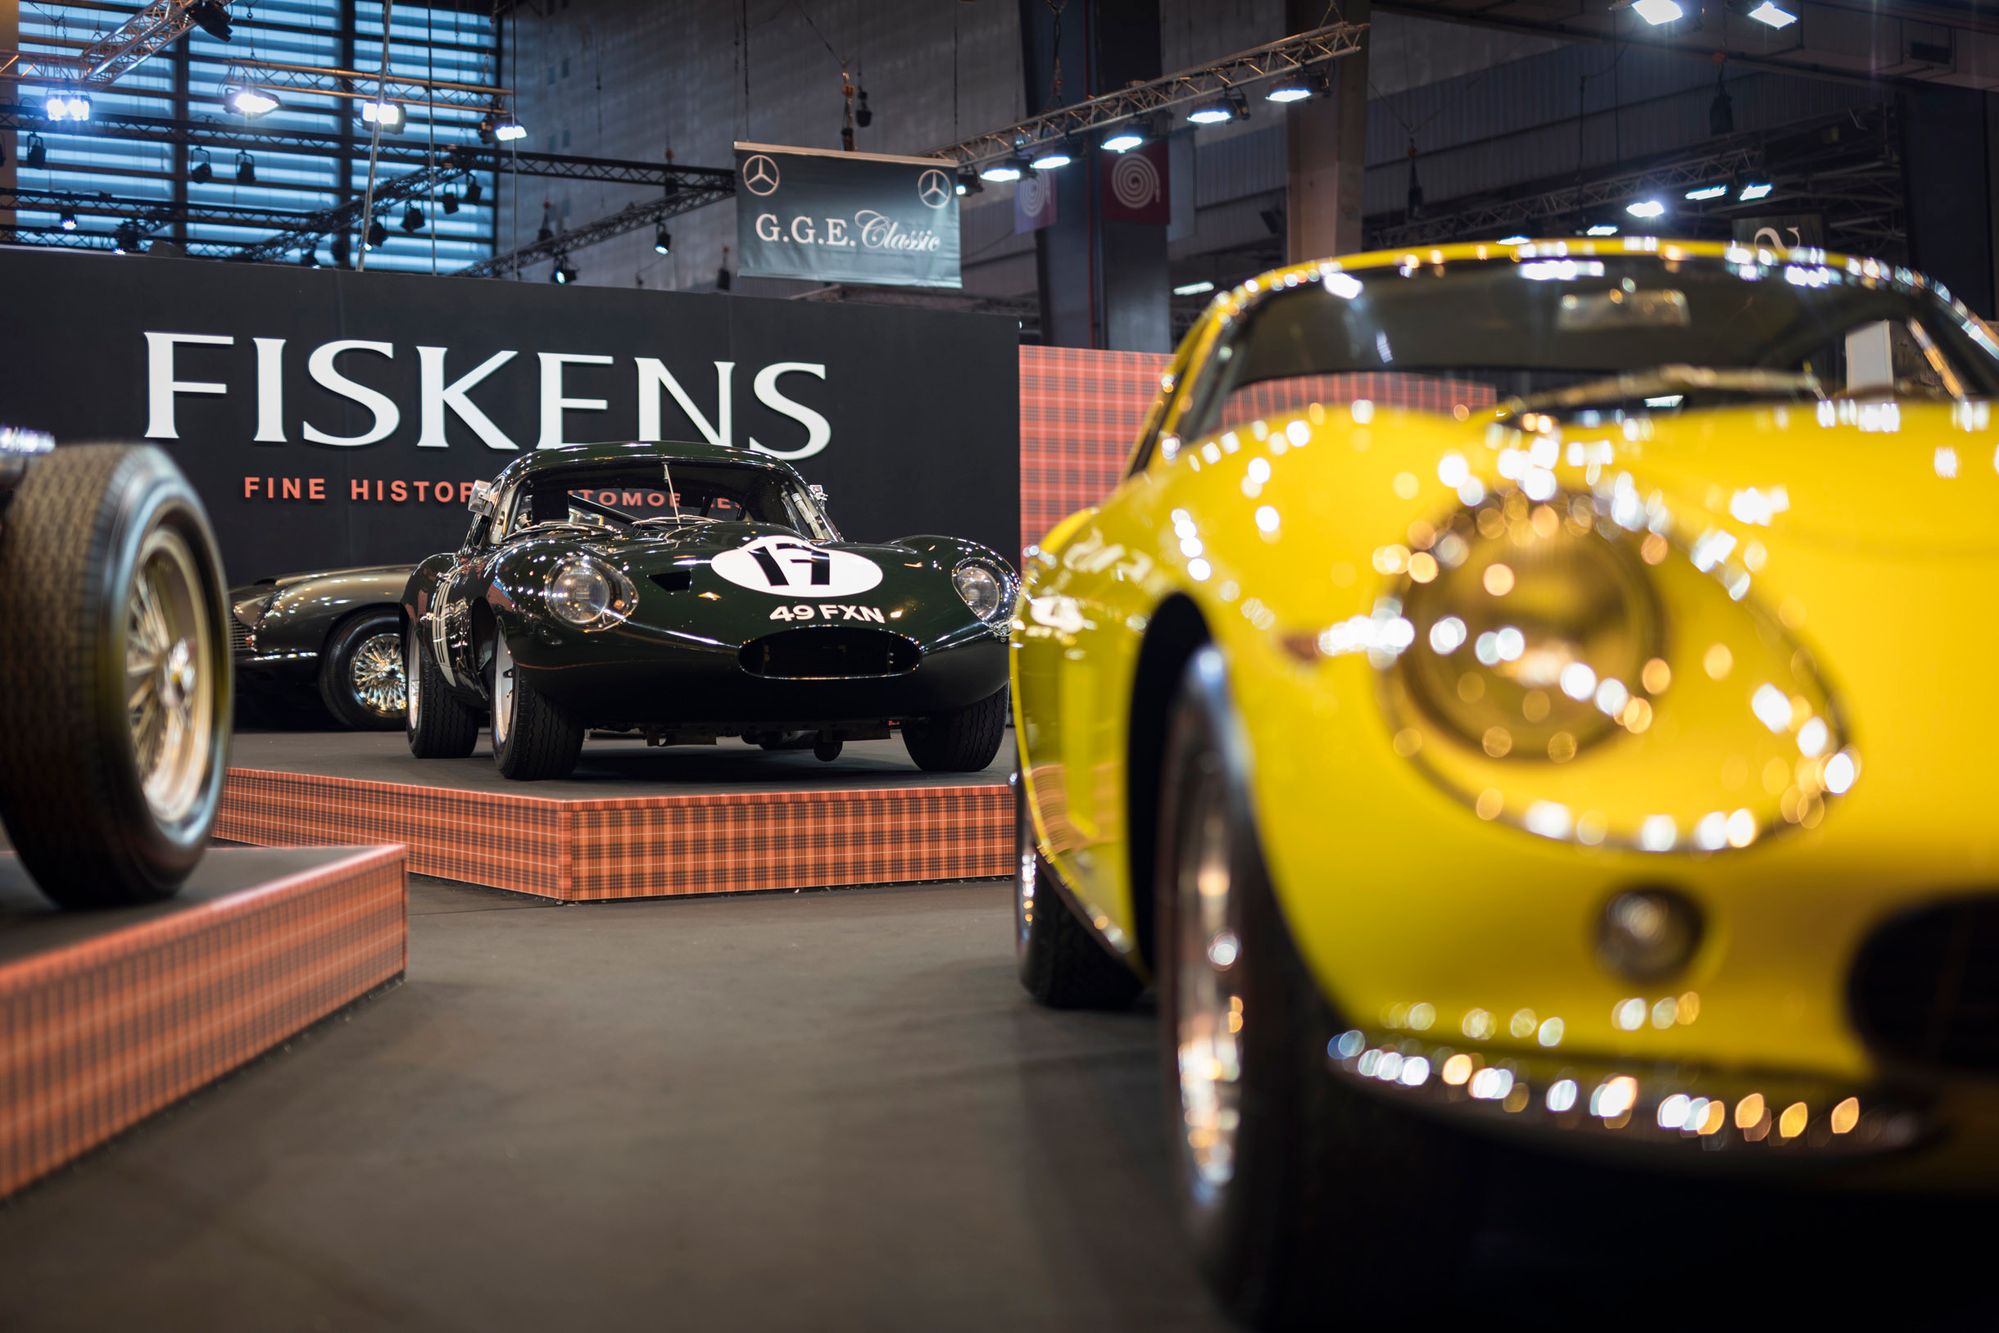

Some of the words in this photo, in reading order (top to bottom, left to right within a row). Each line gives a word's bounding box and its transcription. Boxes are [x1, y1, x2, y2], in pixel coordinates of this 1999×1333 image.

[755, 213, 856, 247] G.G.E.
[854, 209, 941, 251] Classic
[144, 331, 832, 461] FISKENS
[244, 477, 326, 500] FINE
[351, 479, 475, 503] HISTOR
[747, 543, 830, 586] 17
[769, 604, 815, 623] 49
[818, 604, 886, 624] FXN
